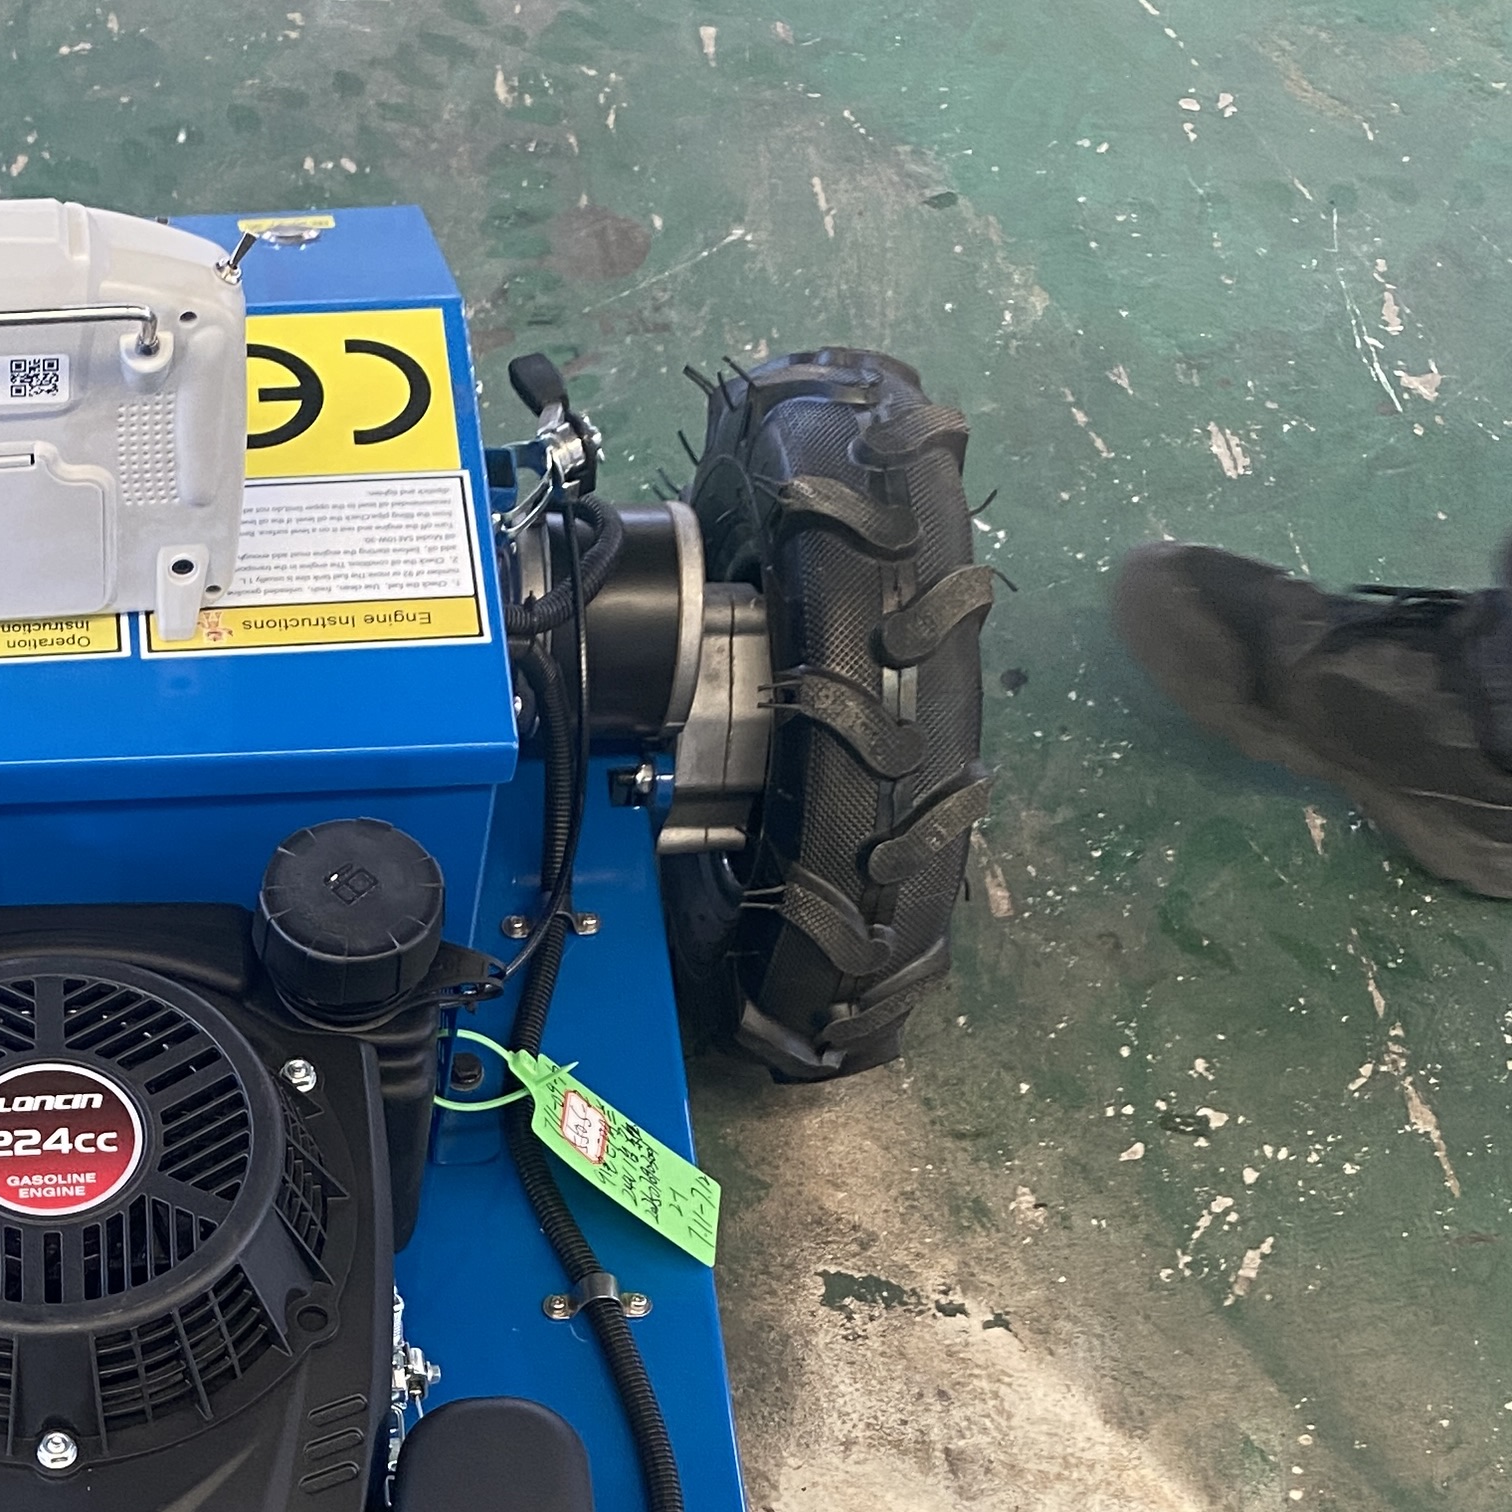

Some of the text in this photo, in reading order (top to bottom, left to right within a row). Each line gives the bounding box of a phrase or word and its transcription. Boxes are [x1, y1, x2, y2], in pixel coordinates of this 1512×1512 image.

[247, 339, 431, 449] CE
[238, 553, 270, 561] enough
[313, 549, 341, 557] engine
[299, 562, 328, 570] engine
[264, 587, 302, 595] unleaded
[422, 580, 447, 589] Check
[242, 610, 431, 631] Engine Instructions
[1, 621, 89, 634] Instruction
[7, 635, 90, 650] Operation
[6, 1173, 97, 1187] GASOLINE
[19, 1186, 86, 1199] ENGINE
